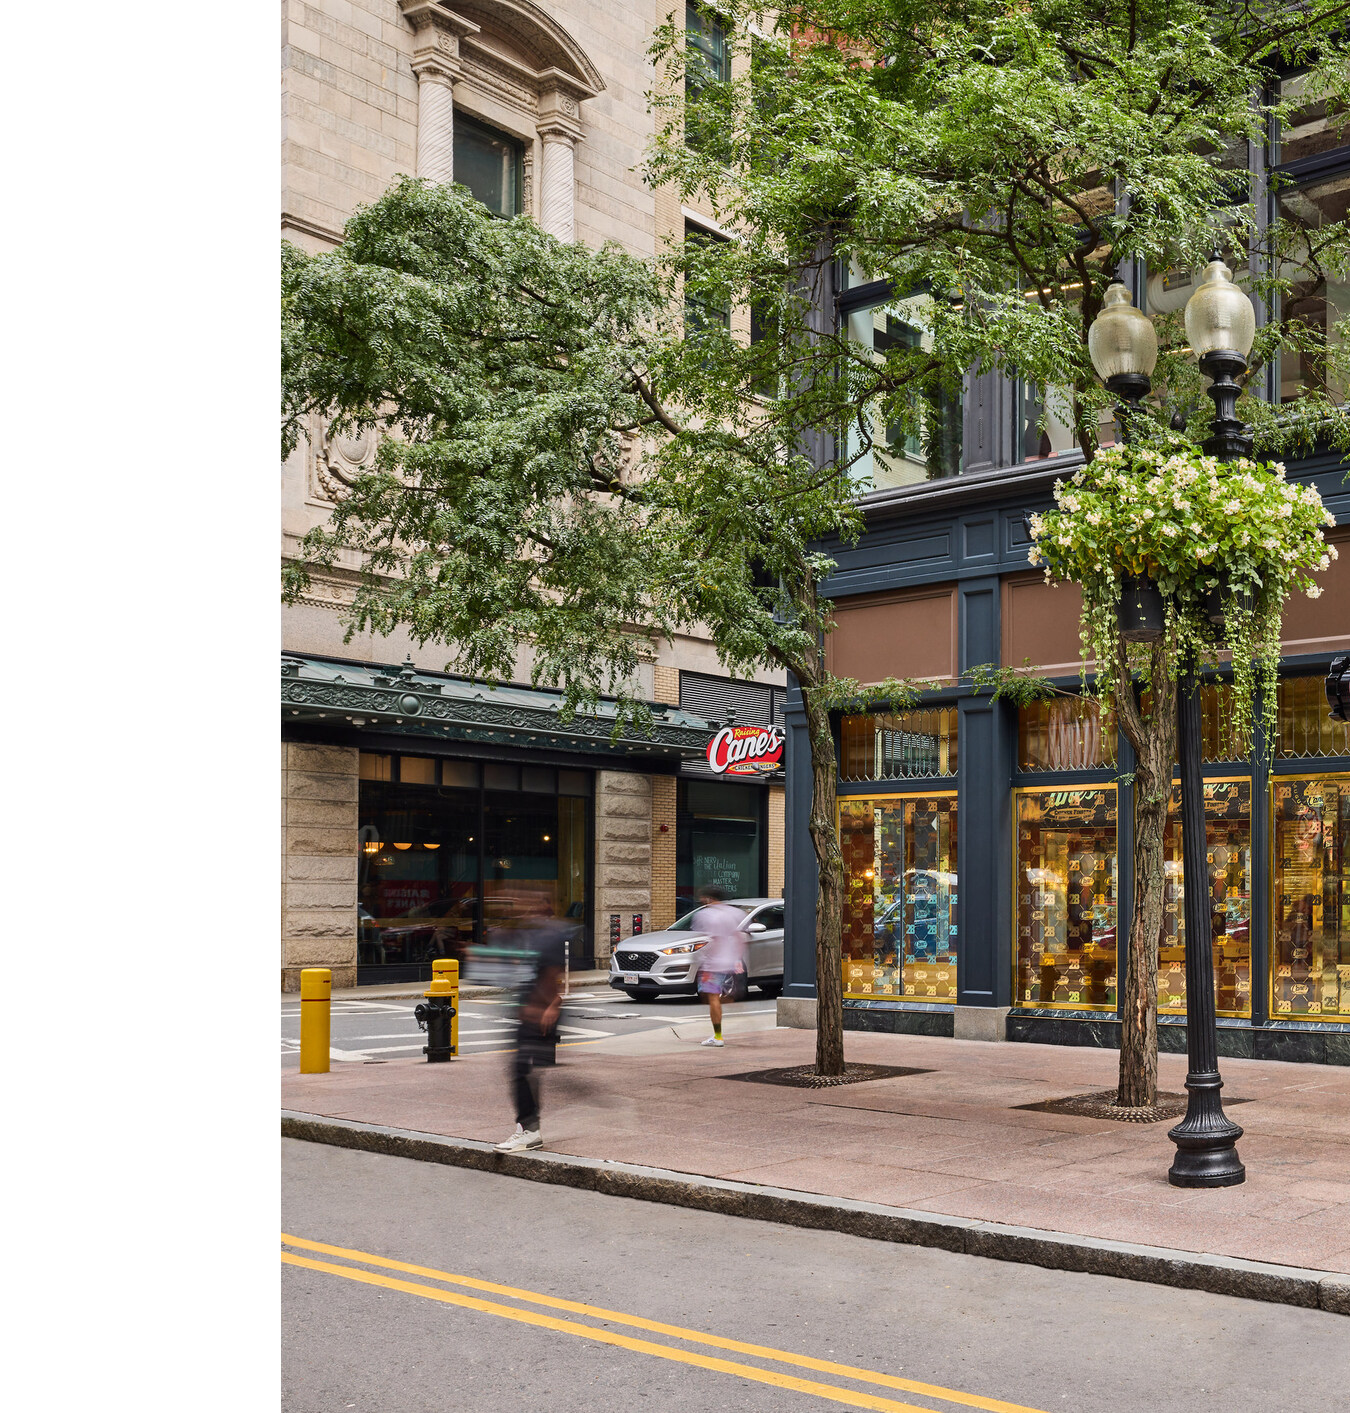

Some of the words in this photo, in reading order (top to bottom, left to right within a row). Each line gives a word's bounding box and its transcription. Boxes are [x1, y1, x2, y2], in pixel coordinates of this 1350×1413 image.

[734, 727, 760, 738] Raising
[709, 725, 782, 774] Cane's
[928, 802, 937, 811] 28
[1227, 852, 1239, 863] 28
[1069, 860, 1080, 871] 28
[1094, 860, 1105, 870] 28
[863, 895, 873, 904] 28
[906, 894, 916, 904] 28
[1021, 894, 1031, 904] 28
[1045, 894, 1055, 905] 28
[1069, 894, 1080, 904] 28
[1094, 894, 1105, 904] 28
[863, 924, 873, 933] 28
[906, 924, 915, 934] 28
[927, 925, 937, 935] 28
[1021, 926, 1031, 936] 28
[1045, 926, 1055, 937] 28
[1069, 926, 1080, 937] 28
[906, 955, 915, 964] 28
[1069, 959, 1080, 970] 28
[1169, 962, 1181, 973] 28
[1279, 965, 1291, 976] 28
[863, 983, 872, 993] 28
[883, 984, 893, 994] 28
[905, 985, 915, 995] 28
[927, 986, 936, 996] 28
[1069, 991, 1080, 1002] 28
[1169, 996, 1181, 1007] 28
[1279, 1001, 1291, 1012] 28
[1308, 1002, 1321, 1013] 28
